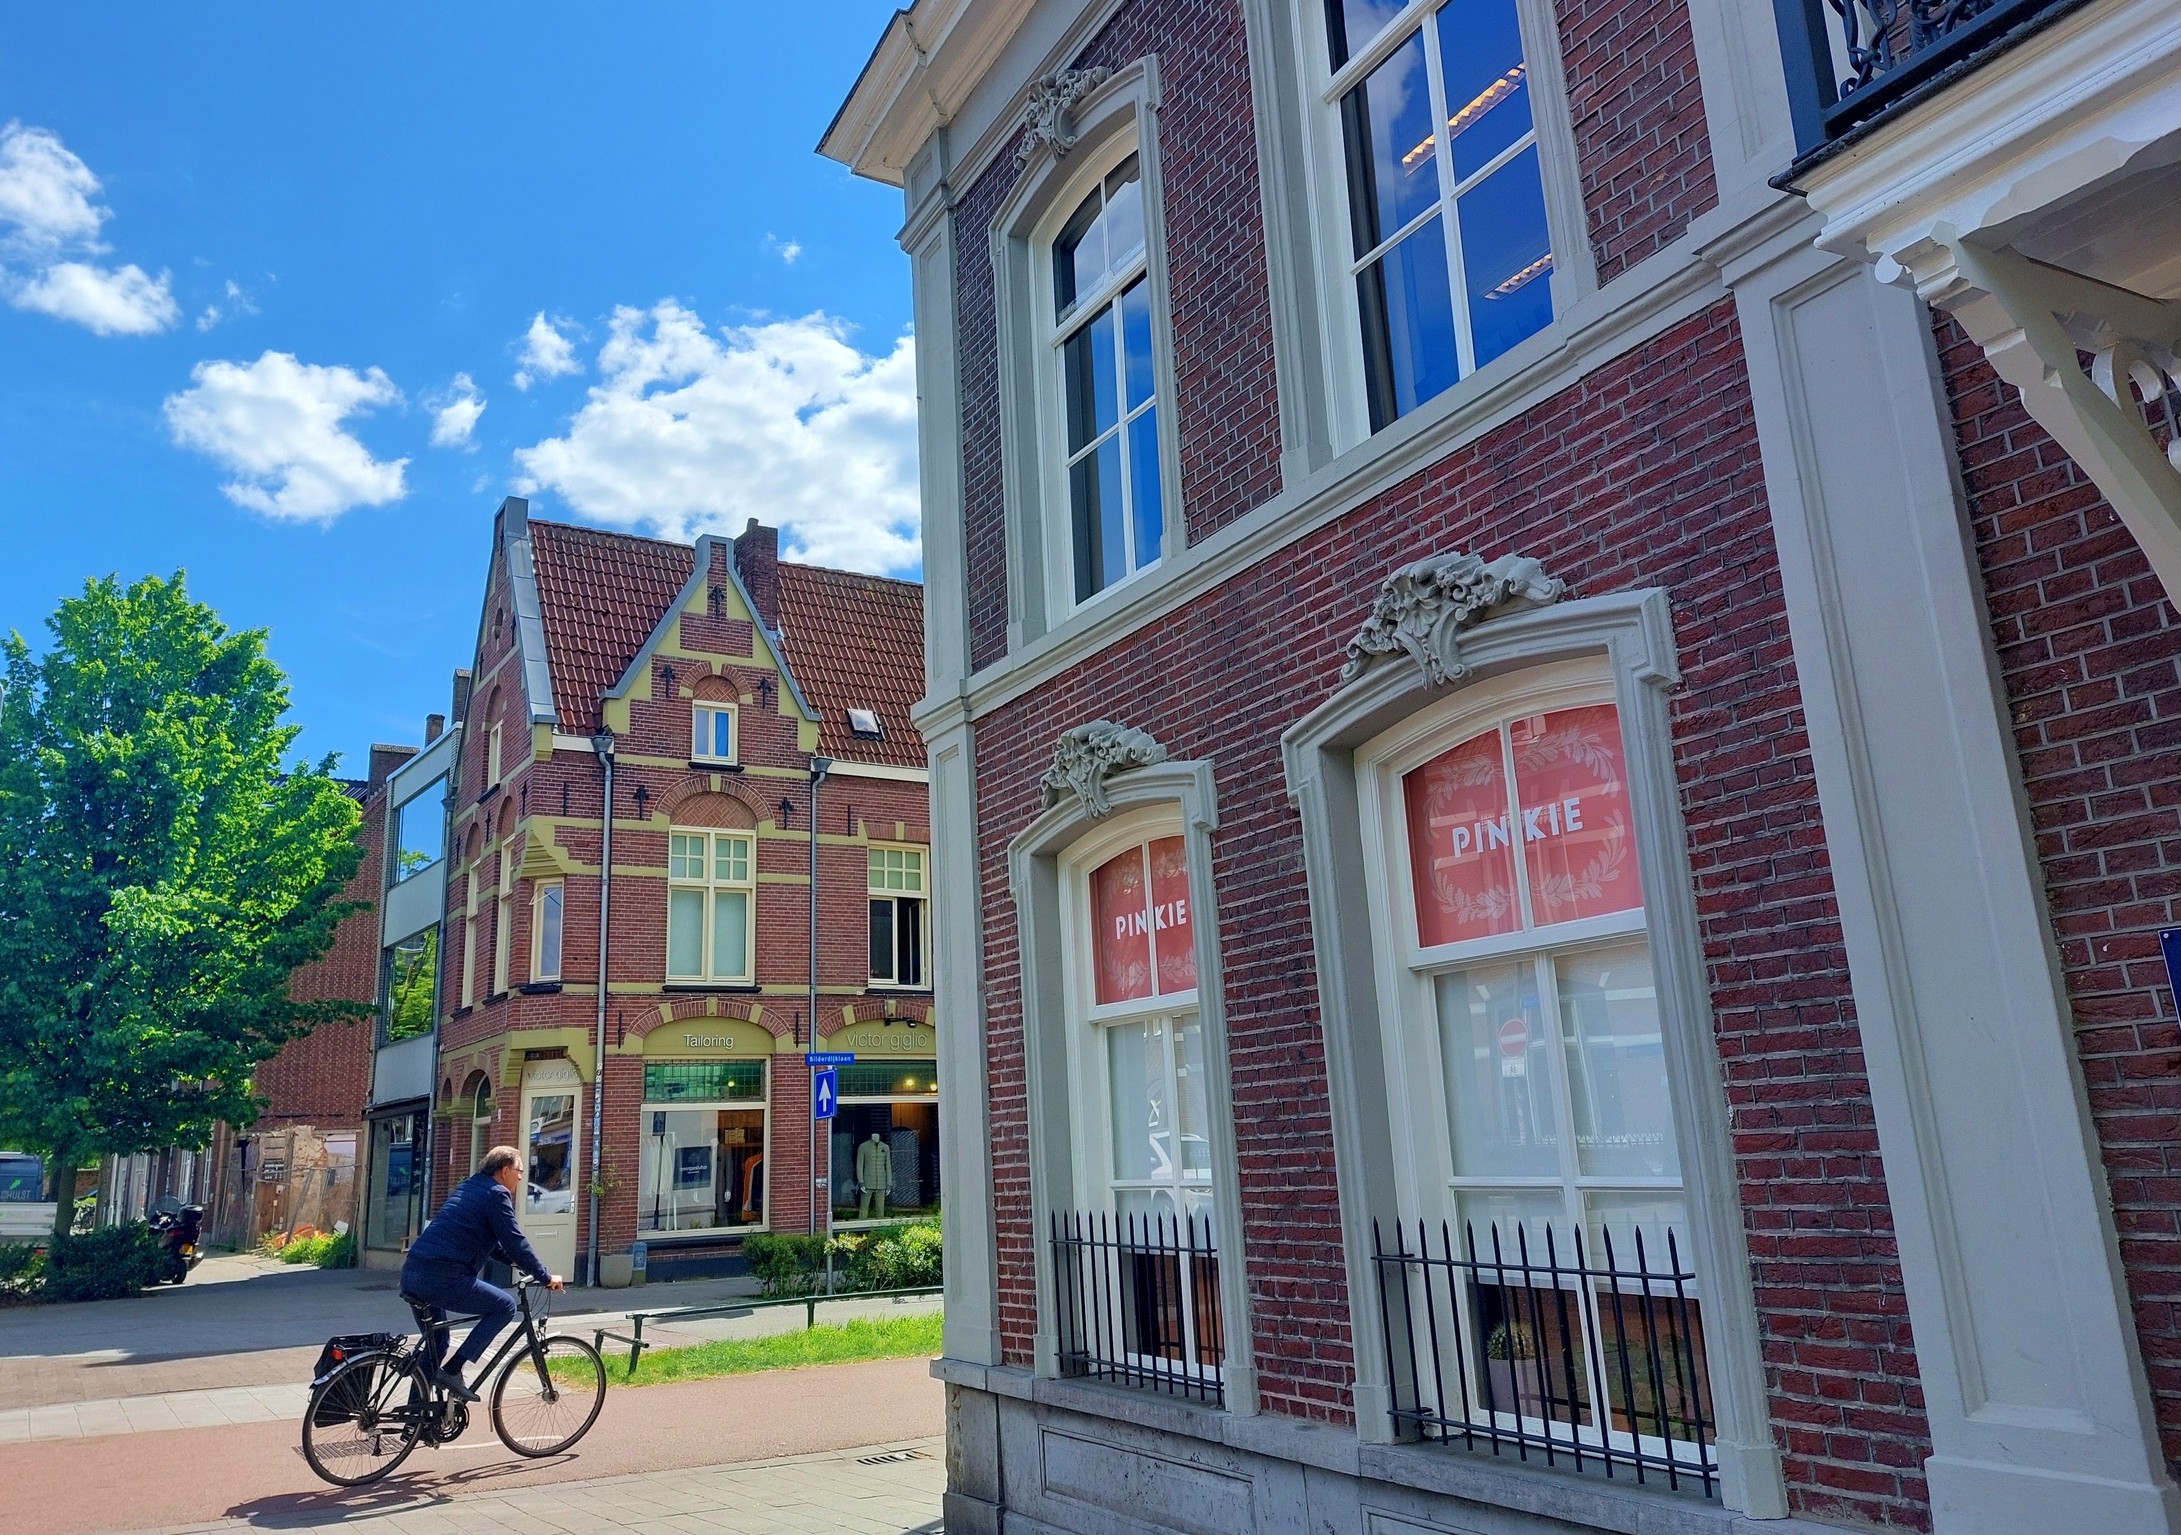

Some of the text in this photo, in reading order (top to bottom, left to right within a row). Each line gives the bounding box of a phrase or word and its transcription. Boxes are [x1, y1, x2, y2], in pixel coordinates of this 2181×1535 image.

[1452, 796, 1584, 859] PINKIE
[1116, 899, 1187, 940] PINKIE
[683, 1034, 734, 1050] Tailoring
[846, 1031, 928, 1051] victor giglio
